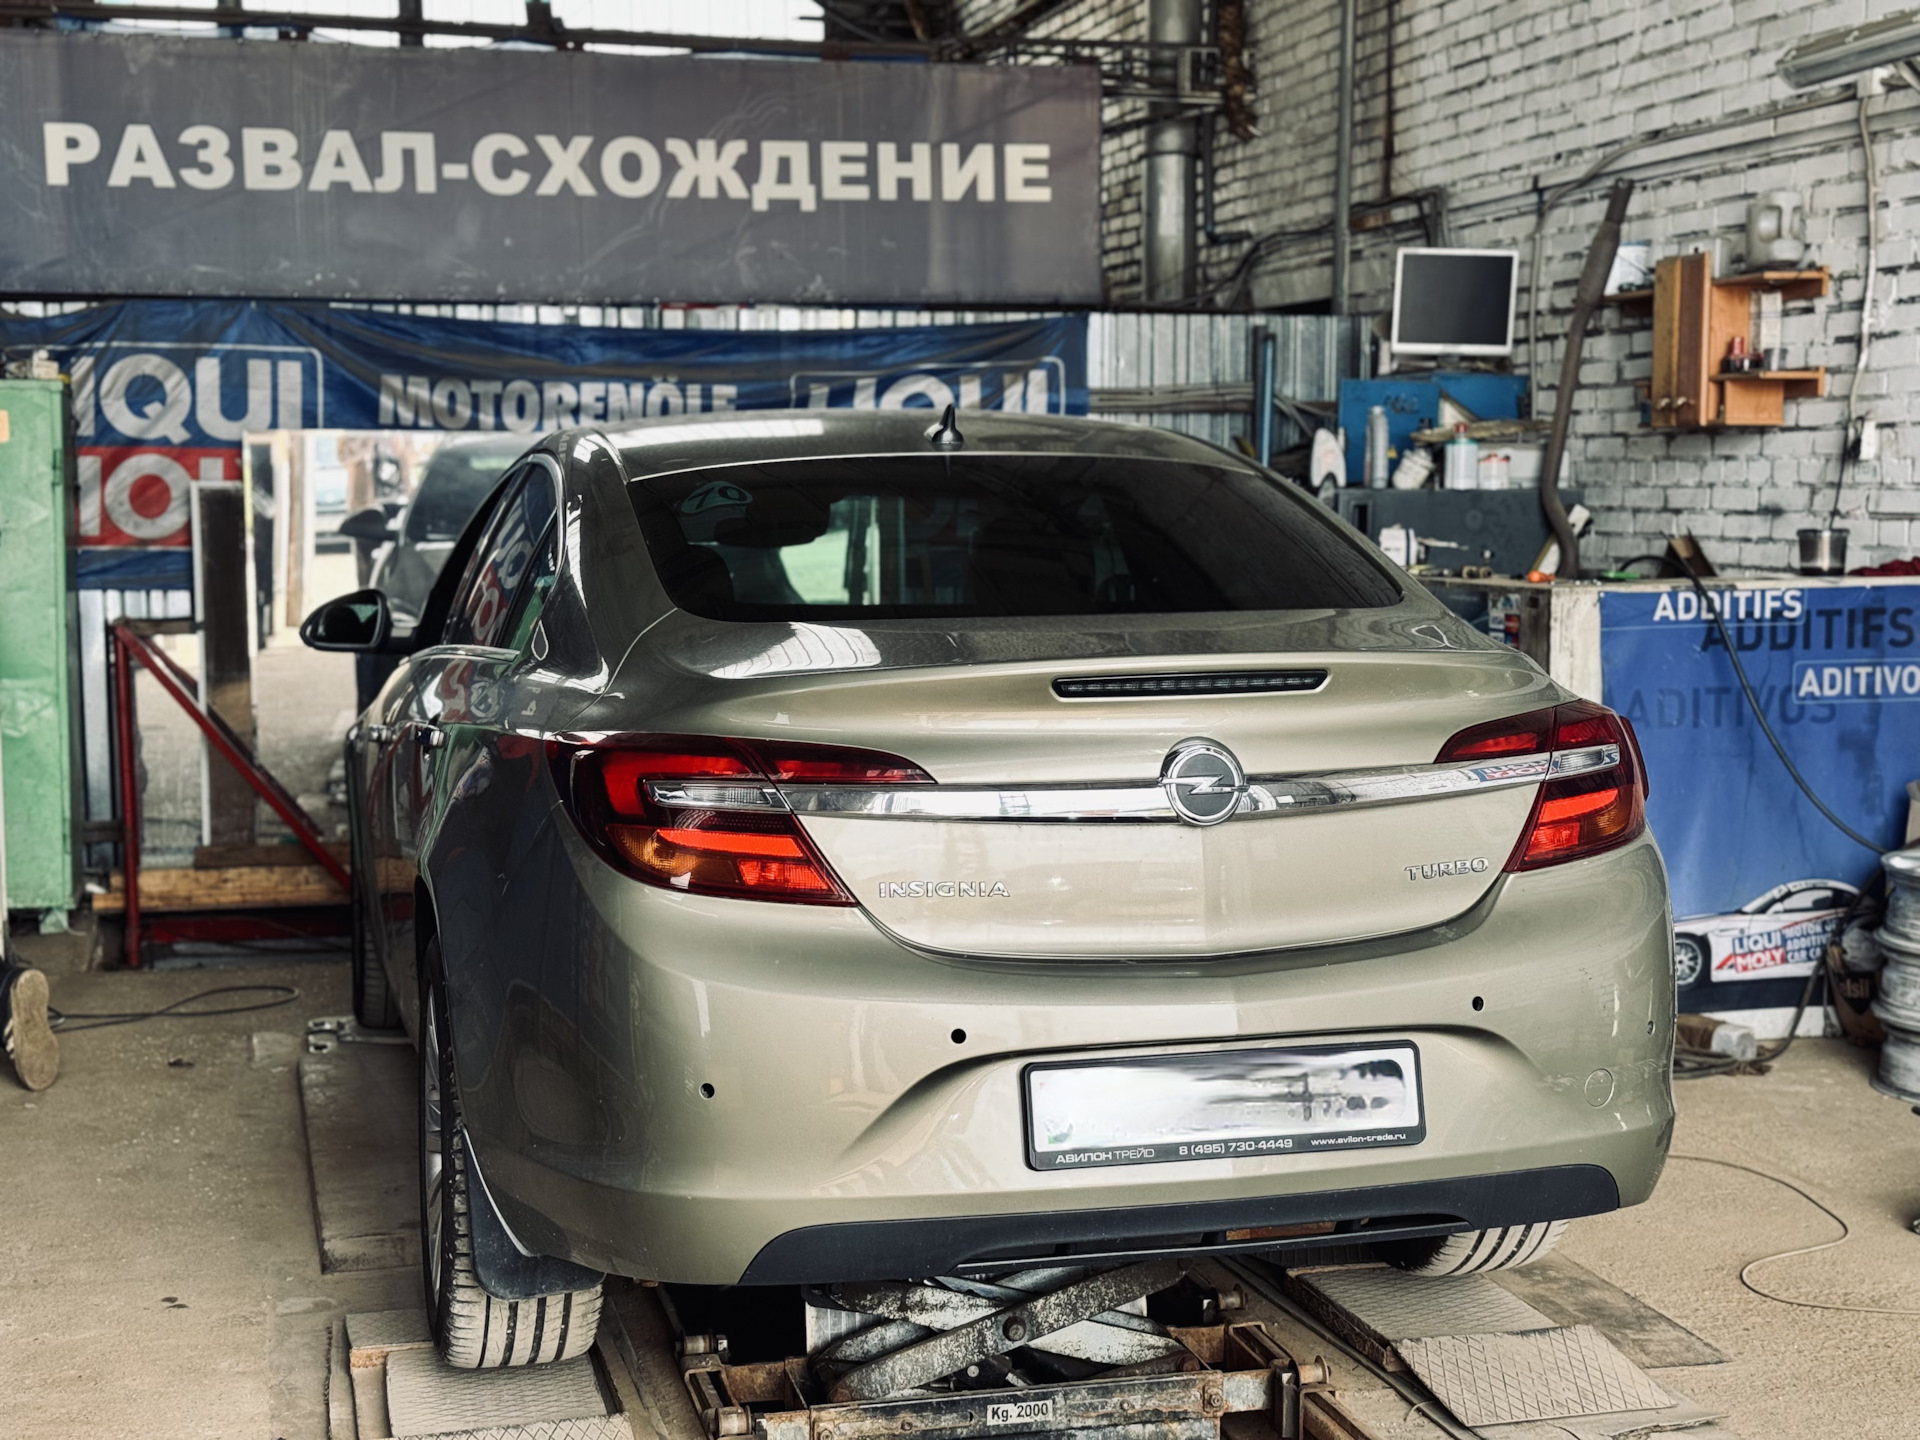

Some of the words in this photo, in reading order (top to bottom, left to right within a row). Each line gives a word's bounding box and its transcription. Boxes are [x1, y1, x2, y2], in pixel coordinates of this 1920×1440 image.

[43, 122, 1053, 212] РАЗВАЛ-СХОЖДЕНИЕ
[71, 353, 302, 446] IQUI
[1653, 589, 1802, 621] ADDITIFS
[1701, 607, 1915, 652] ADDITIFS
[1799, 665, 1920, 697] ADITIVO
[1404, 857, 1489, 881] TURBO
[879, 881, 1010, 898] INSIGNIA
[1735, 931, 1782, 954] LIQUI
[1786, 933, 1831, 951] ADDITIV
[1737, 949, 1784, 972] MOLY
[1055, 1151, 1112, 1164] АВИЛОН
[1179, 1146, 1188, 1155] 8
[1191, 1143, 1225, 1155] (495)
[1228, 1139, 1293, 1152] 730-4449
[991, 1407, 1012, 1422] Kg.
[1016, 1403, 1049, 1418] 2000
